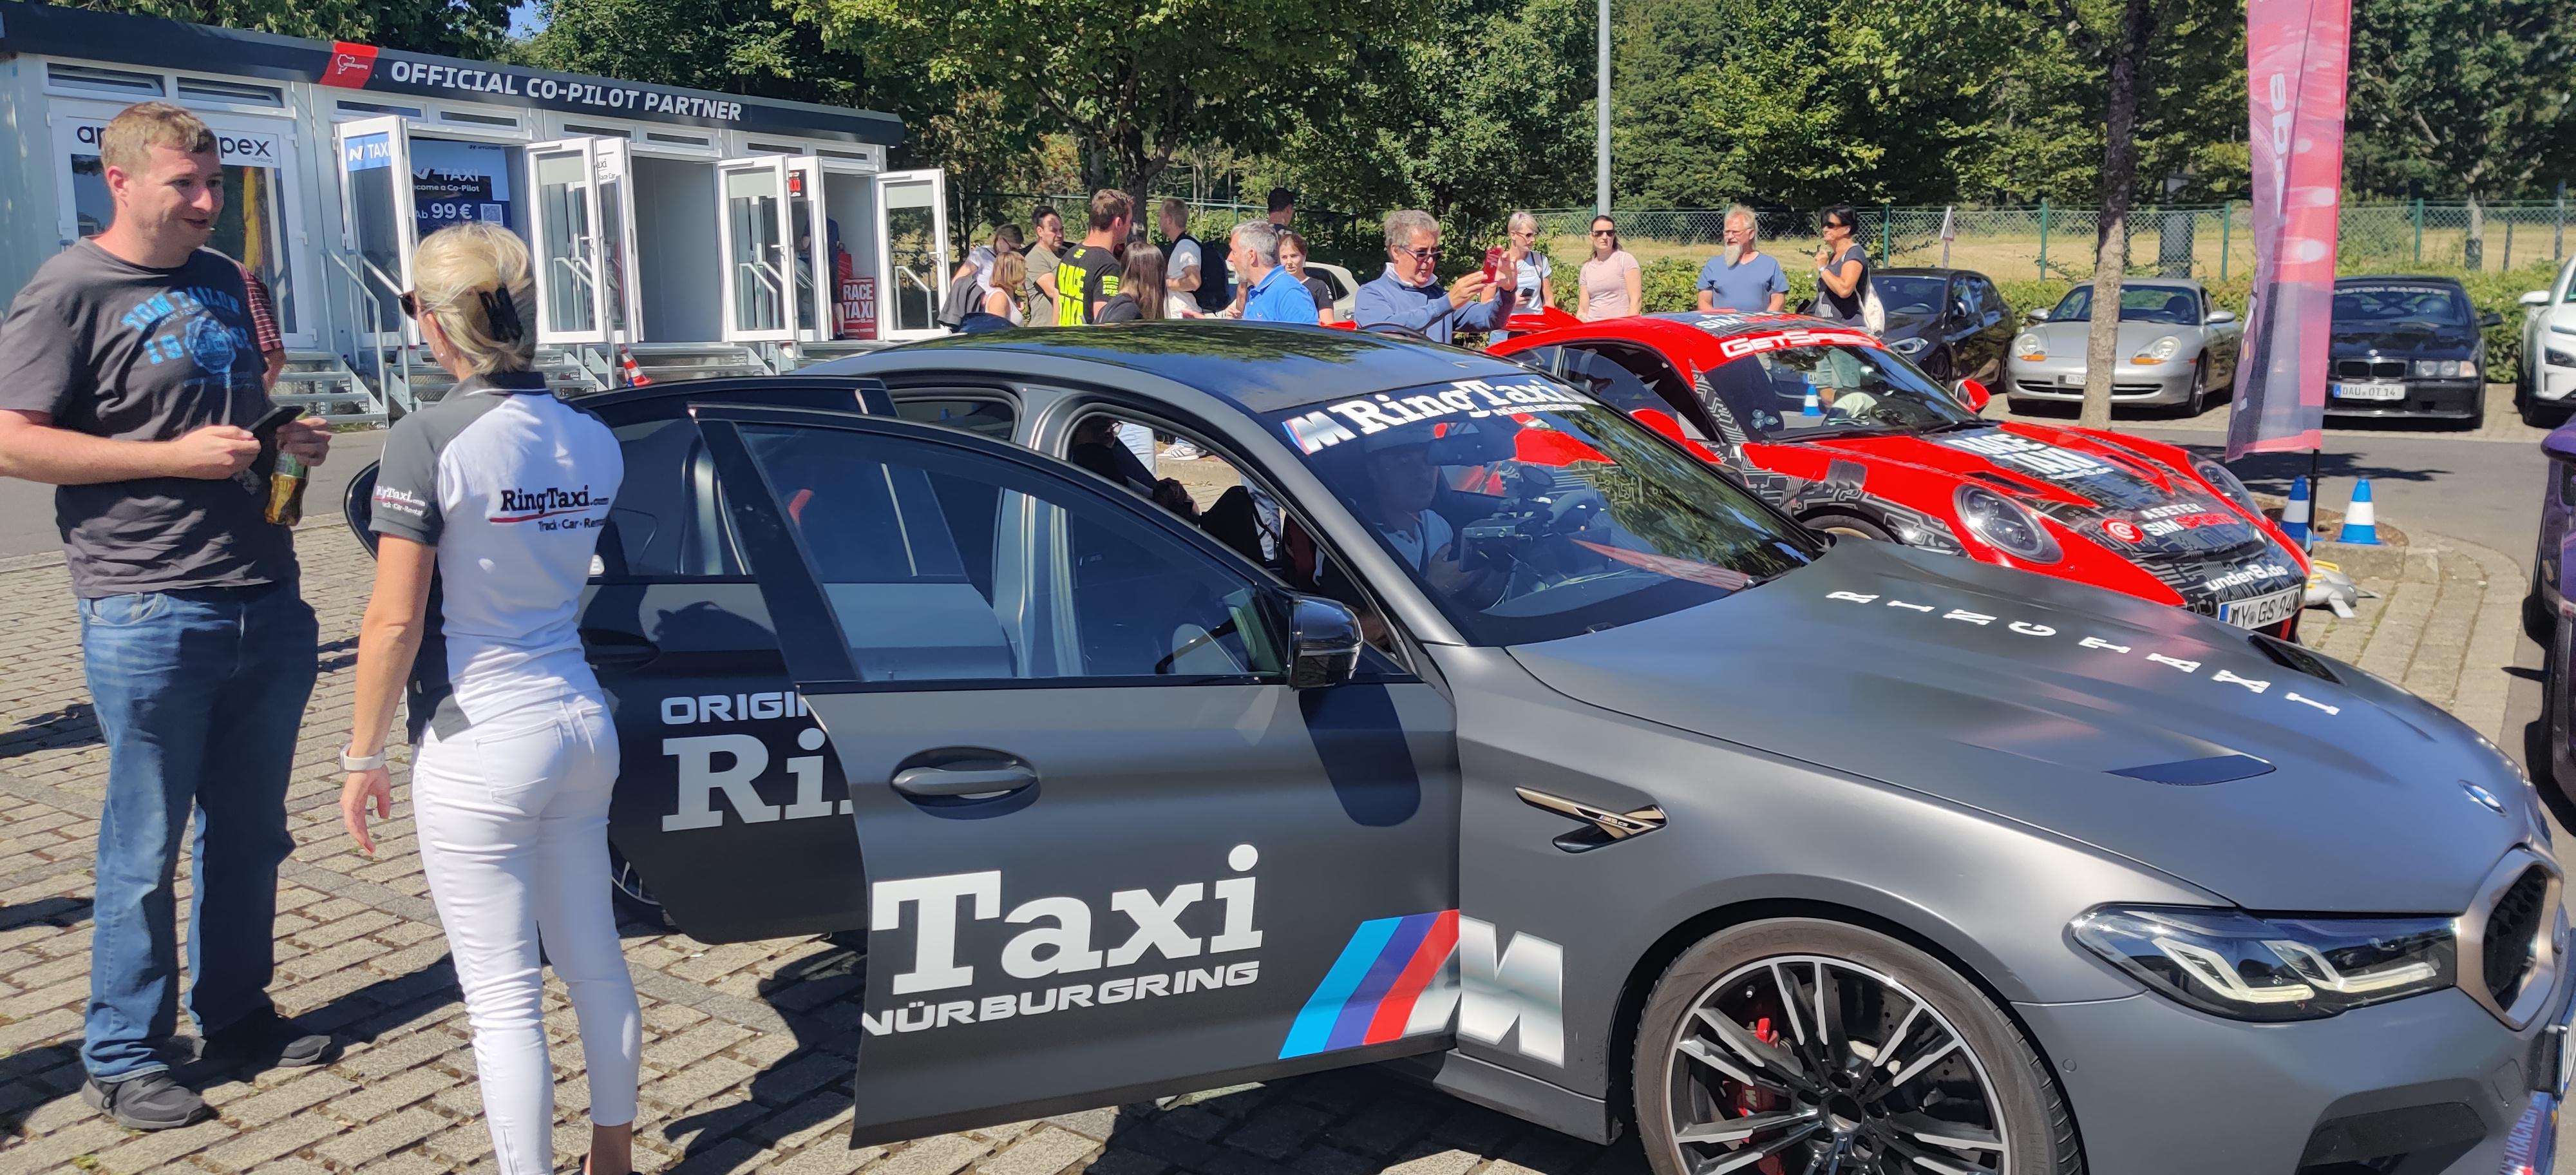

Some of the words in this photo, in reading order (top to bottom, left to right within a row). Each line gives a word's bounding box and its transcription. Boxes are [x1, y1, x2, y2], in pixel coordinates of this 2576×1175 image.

[392, 61, 518, 95] OFFICIAL
[527, 78, 640, 109] CO-PILOT
[644, 93, 742, 120] PARTNER
[368, 141, 391, 158] TAXI
[440, 169, 479, 182] TAXI
[447, 184, 480, 193] Co-Pilot
[431, 203, 457, 219] 99
[459, 204, 473, 219] €
[843, 284, 874, 300] RACE
[1058, 263, 1086, 300] RACE
[120, 292, 175, 331] TOM
[844, 301, 874, 319] TAXI
[1327, 380, 1561, 435] RingTaxi
[1993, 447, 2101, 475] TAXI
[2140, 503, 2206, 519] ASETEK
[562, 519, 579, 530] Car
[2258, 599, 2277, 623] GS
[871, 844, 1264, 995] Taxi
[862, 960, 1260, 1036] NÜRBURGRING
